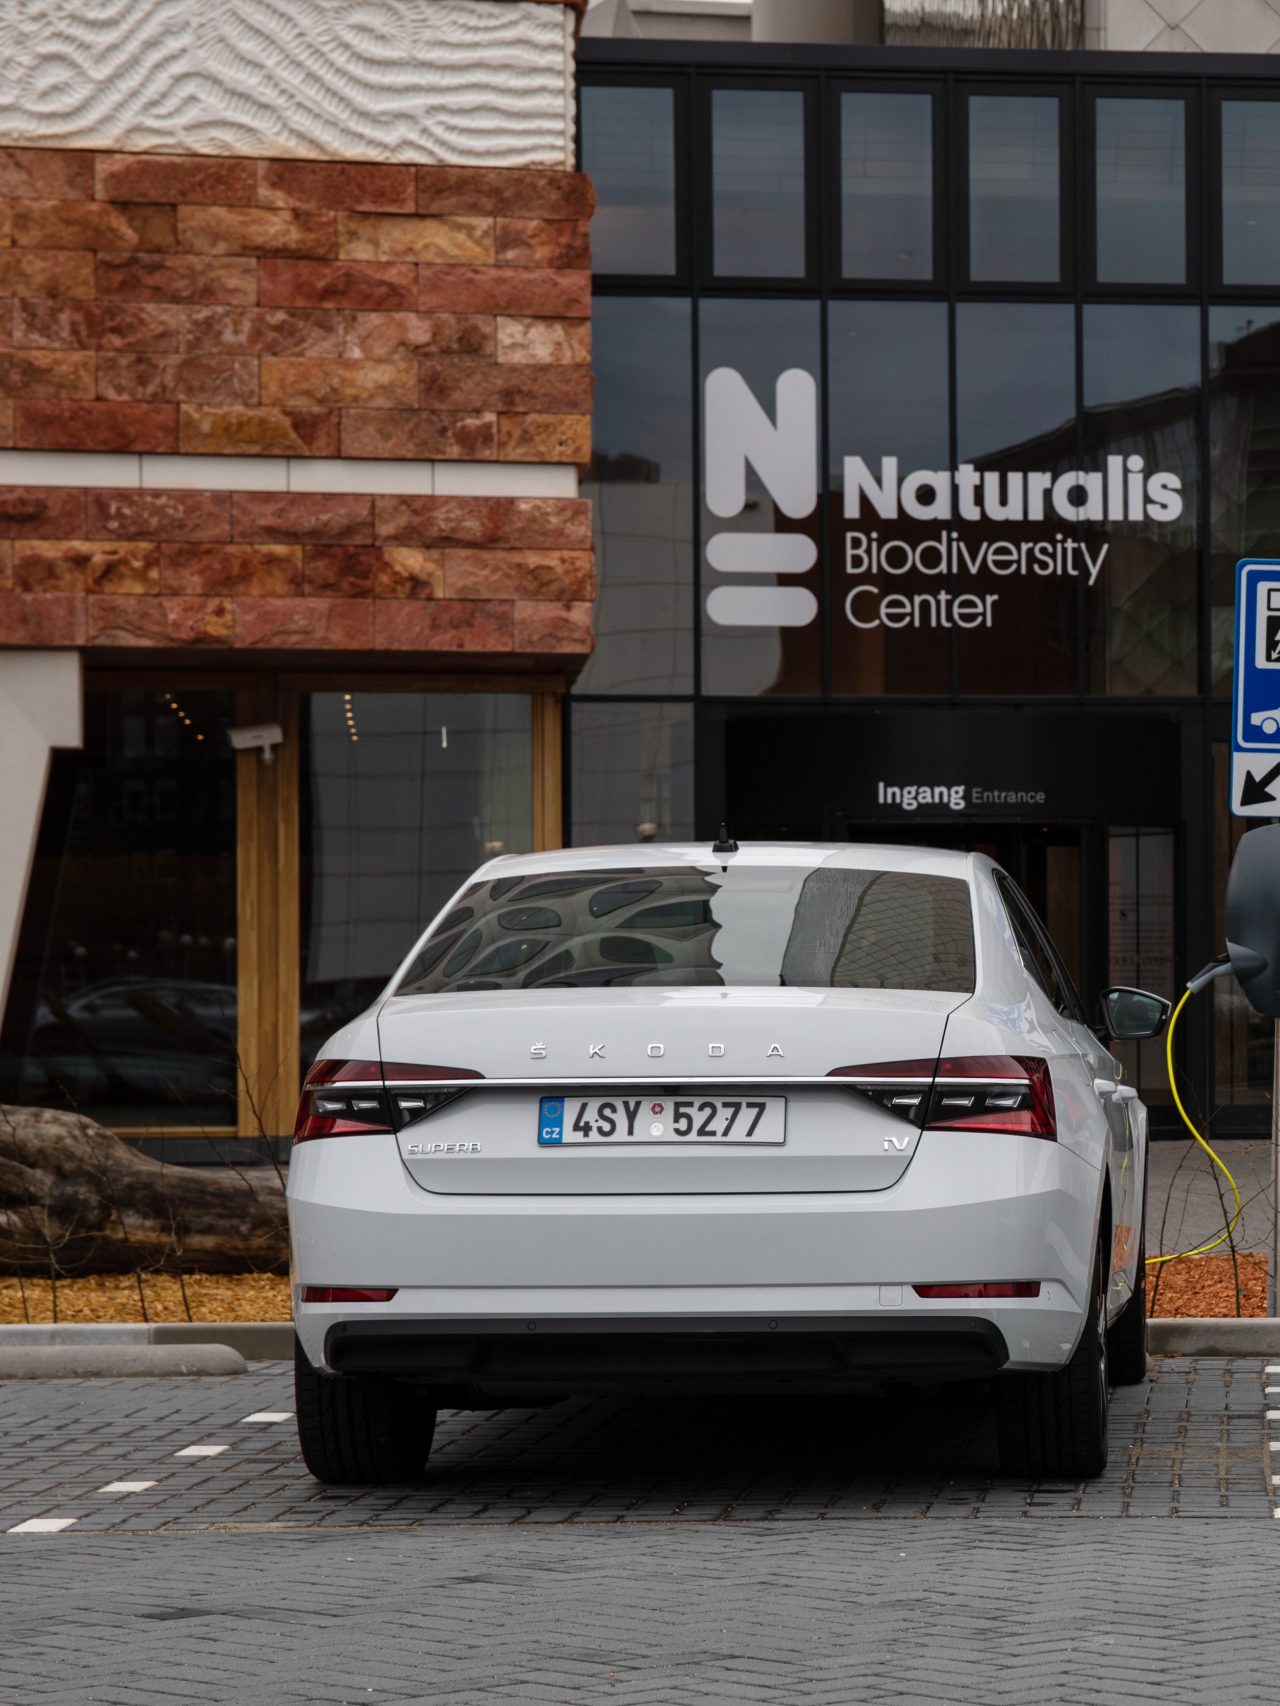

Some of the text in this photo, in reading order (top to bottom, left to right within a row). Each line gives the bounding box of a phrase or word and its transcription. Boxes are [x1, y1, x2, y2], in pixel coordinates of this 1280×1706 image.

[843, 454, 1184, 522] Naturalis
[845, 530, 1109, 586] Biodiversity
[845, 585, 998, 629] Center
[878, 781, 1046, 811] Ingang Entrance
[530, 1042, 785, 1059] ŠKODA
[542, 1100, 767, 1139] CZ 4SY 5277
[407, 1142, 482, 1155] SUPERB
